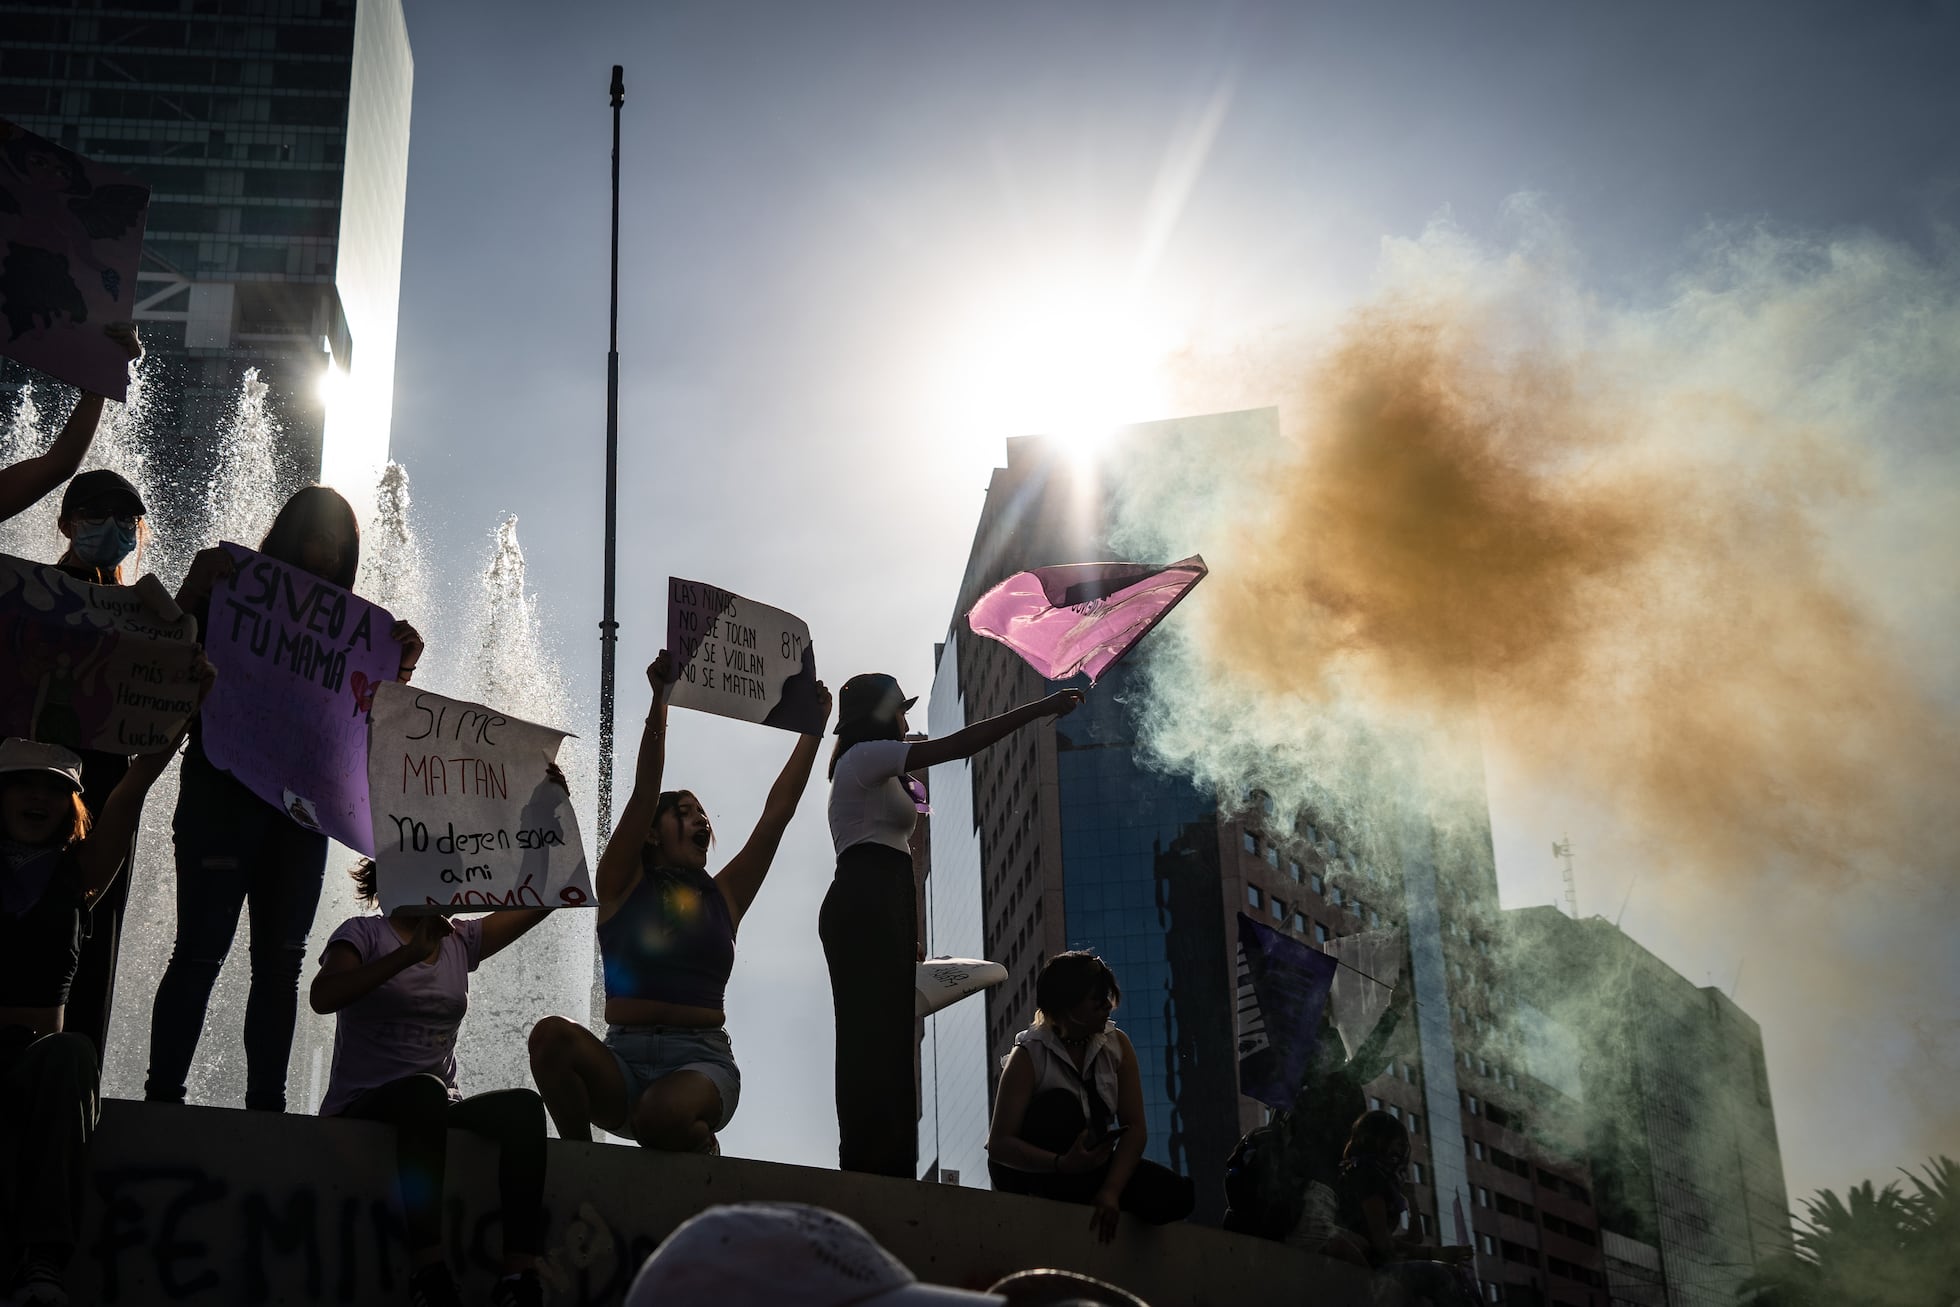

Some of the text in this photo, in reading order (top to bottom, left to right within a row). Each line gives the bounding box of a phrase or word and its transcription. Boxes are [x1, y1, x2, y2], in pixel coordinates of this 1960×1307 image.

[229, 555, 371, 652] Y SI VEO A
[674, 582, 697, 606] LAS
[225, 597, 272, 657] TU
[273, 624, 352, 693] MAMÁ
[680, 610, 757, 650] NO SE TOCAN
[781, 631, 803, 662] 8M
[679, 636, 764, 677] NO SE VIOLAN
[117, 682, 192, 714] Hermanas
[678, 662, 766, 701] NO SE MATAN
[406, 693, 446, 739] SI
[403, 753, 507, 800] MATAN
